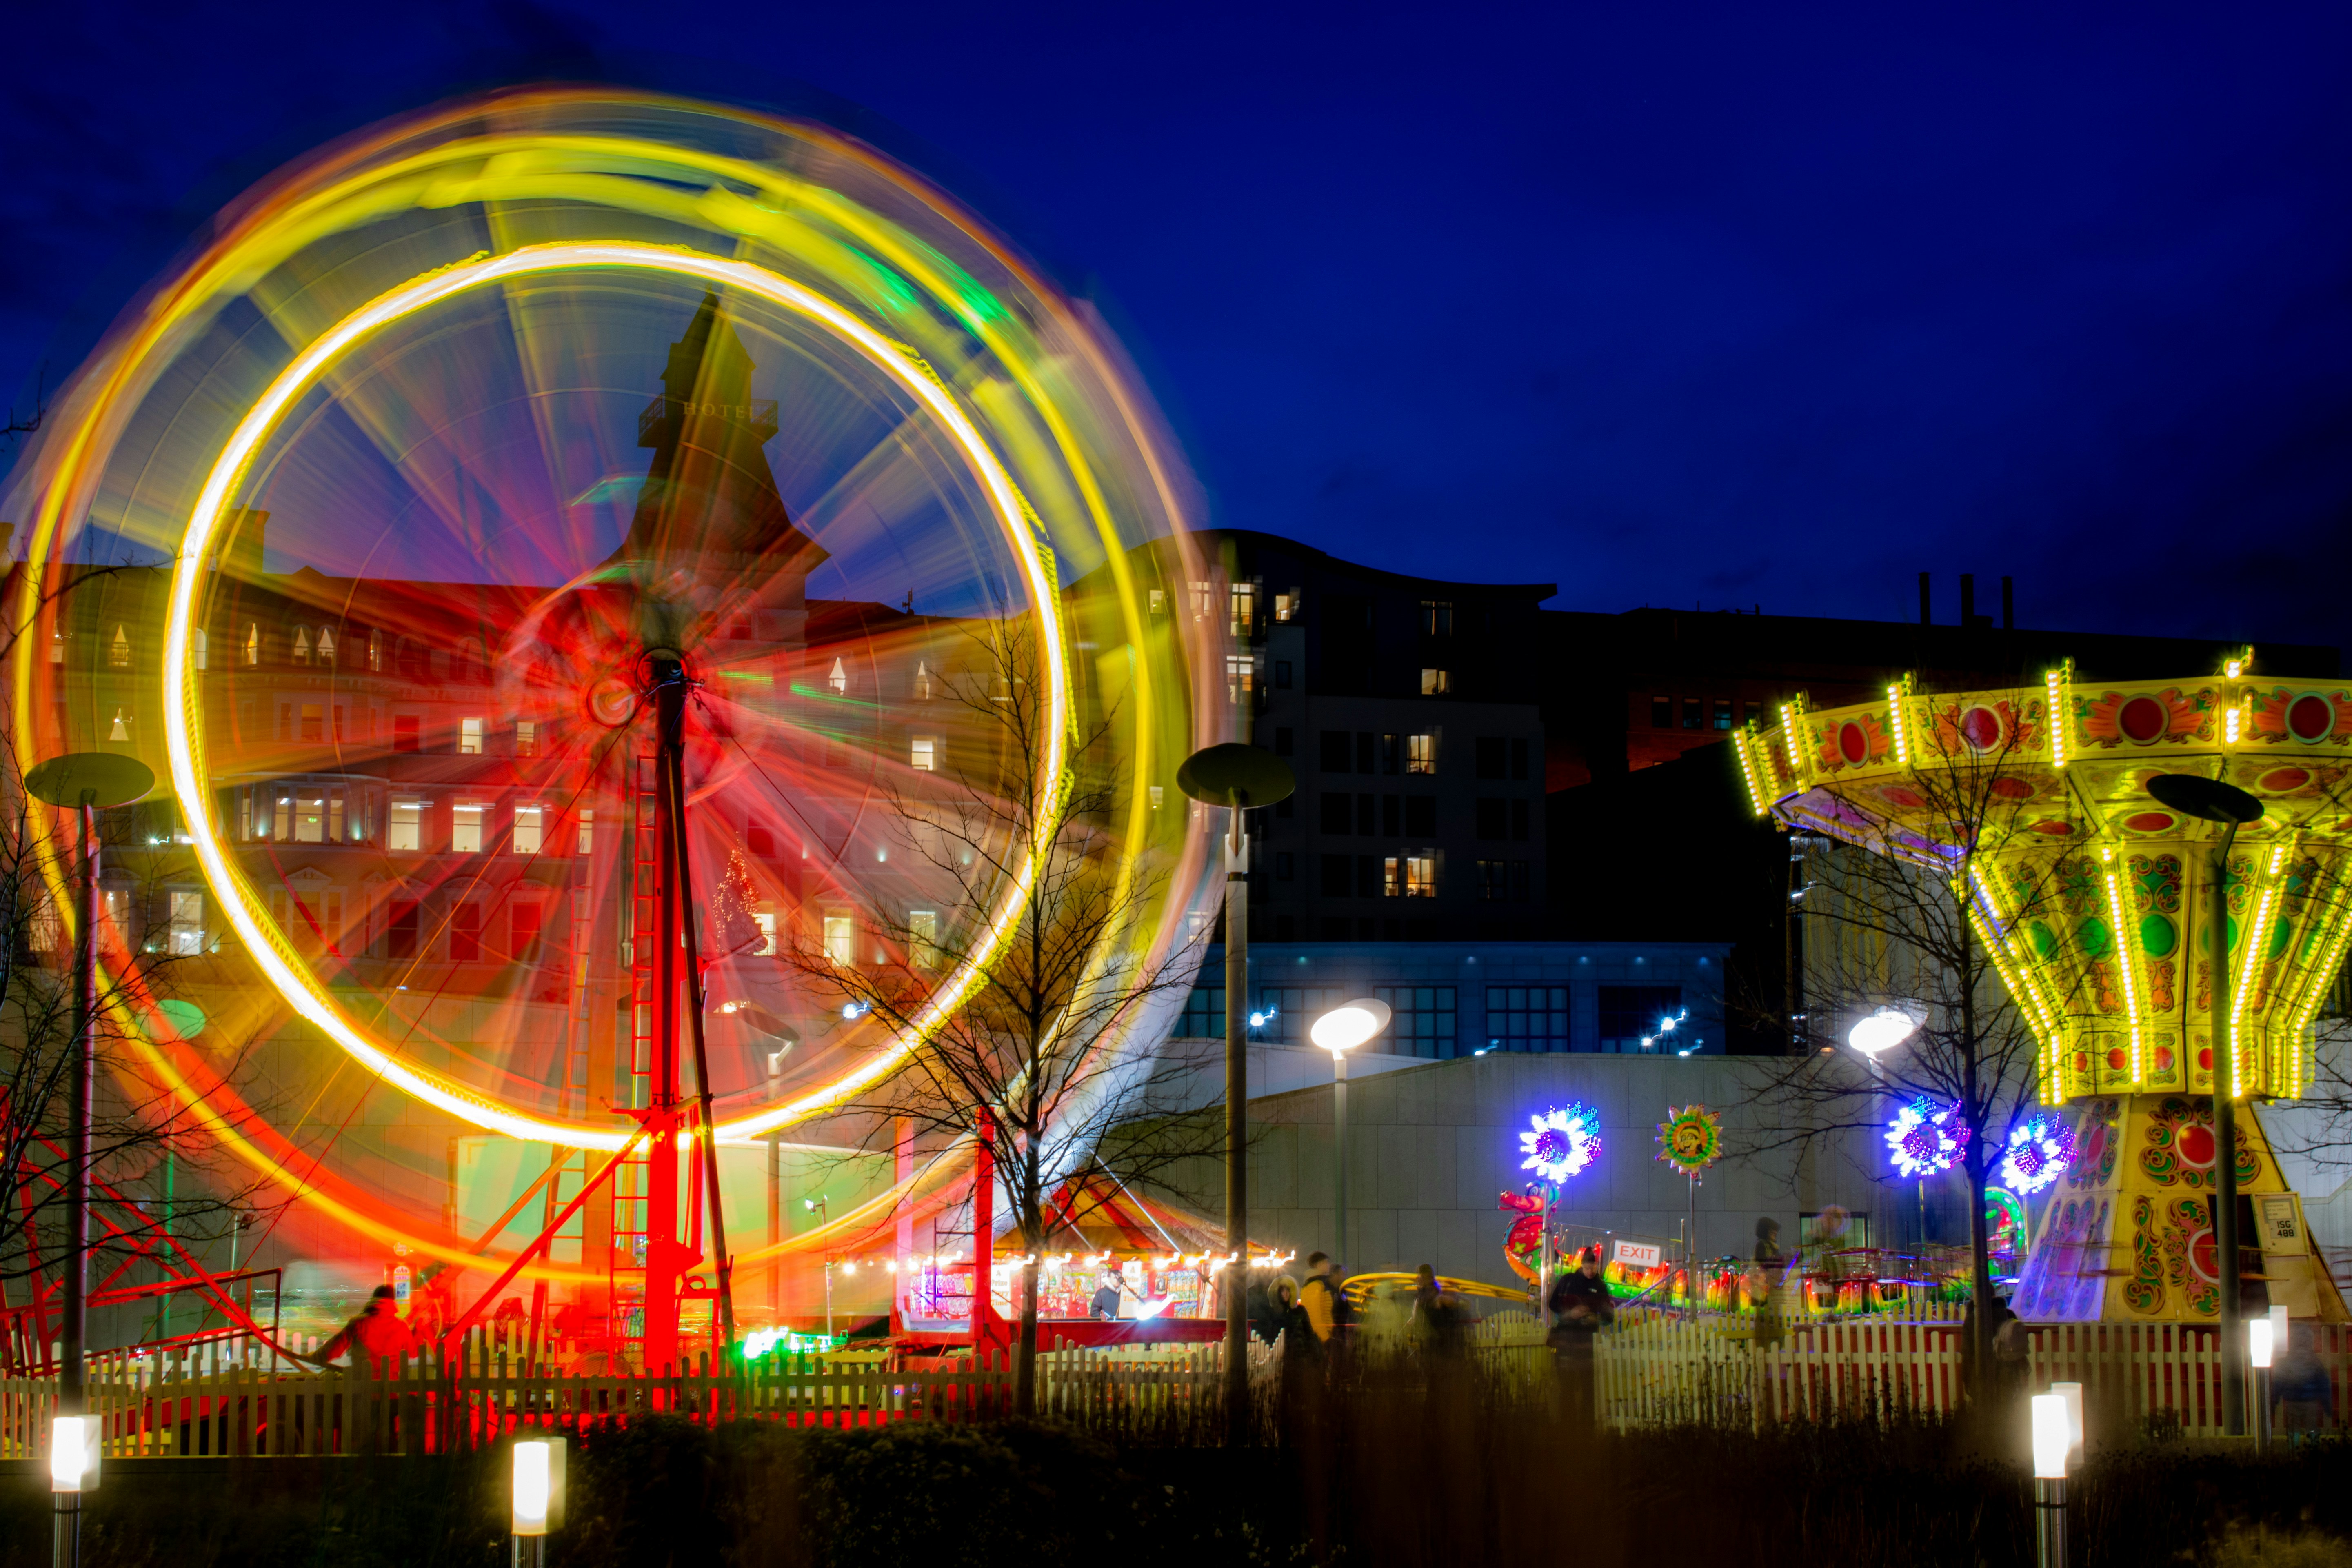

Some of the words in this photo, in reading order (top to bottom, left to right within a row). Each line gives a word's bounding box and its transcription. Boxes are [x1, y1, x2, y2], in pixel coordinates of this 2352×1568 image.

[682, 401, 758, 420] HOTEL
[2277, 1229, 2294, 1237] 488
[1619, 1245, 1655, 1260] EXIT
